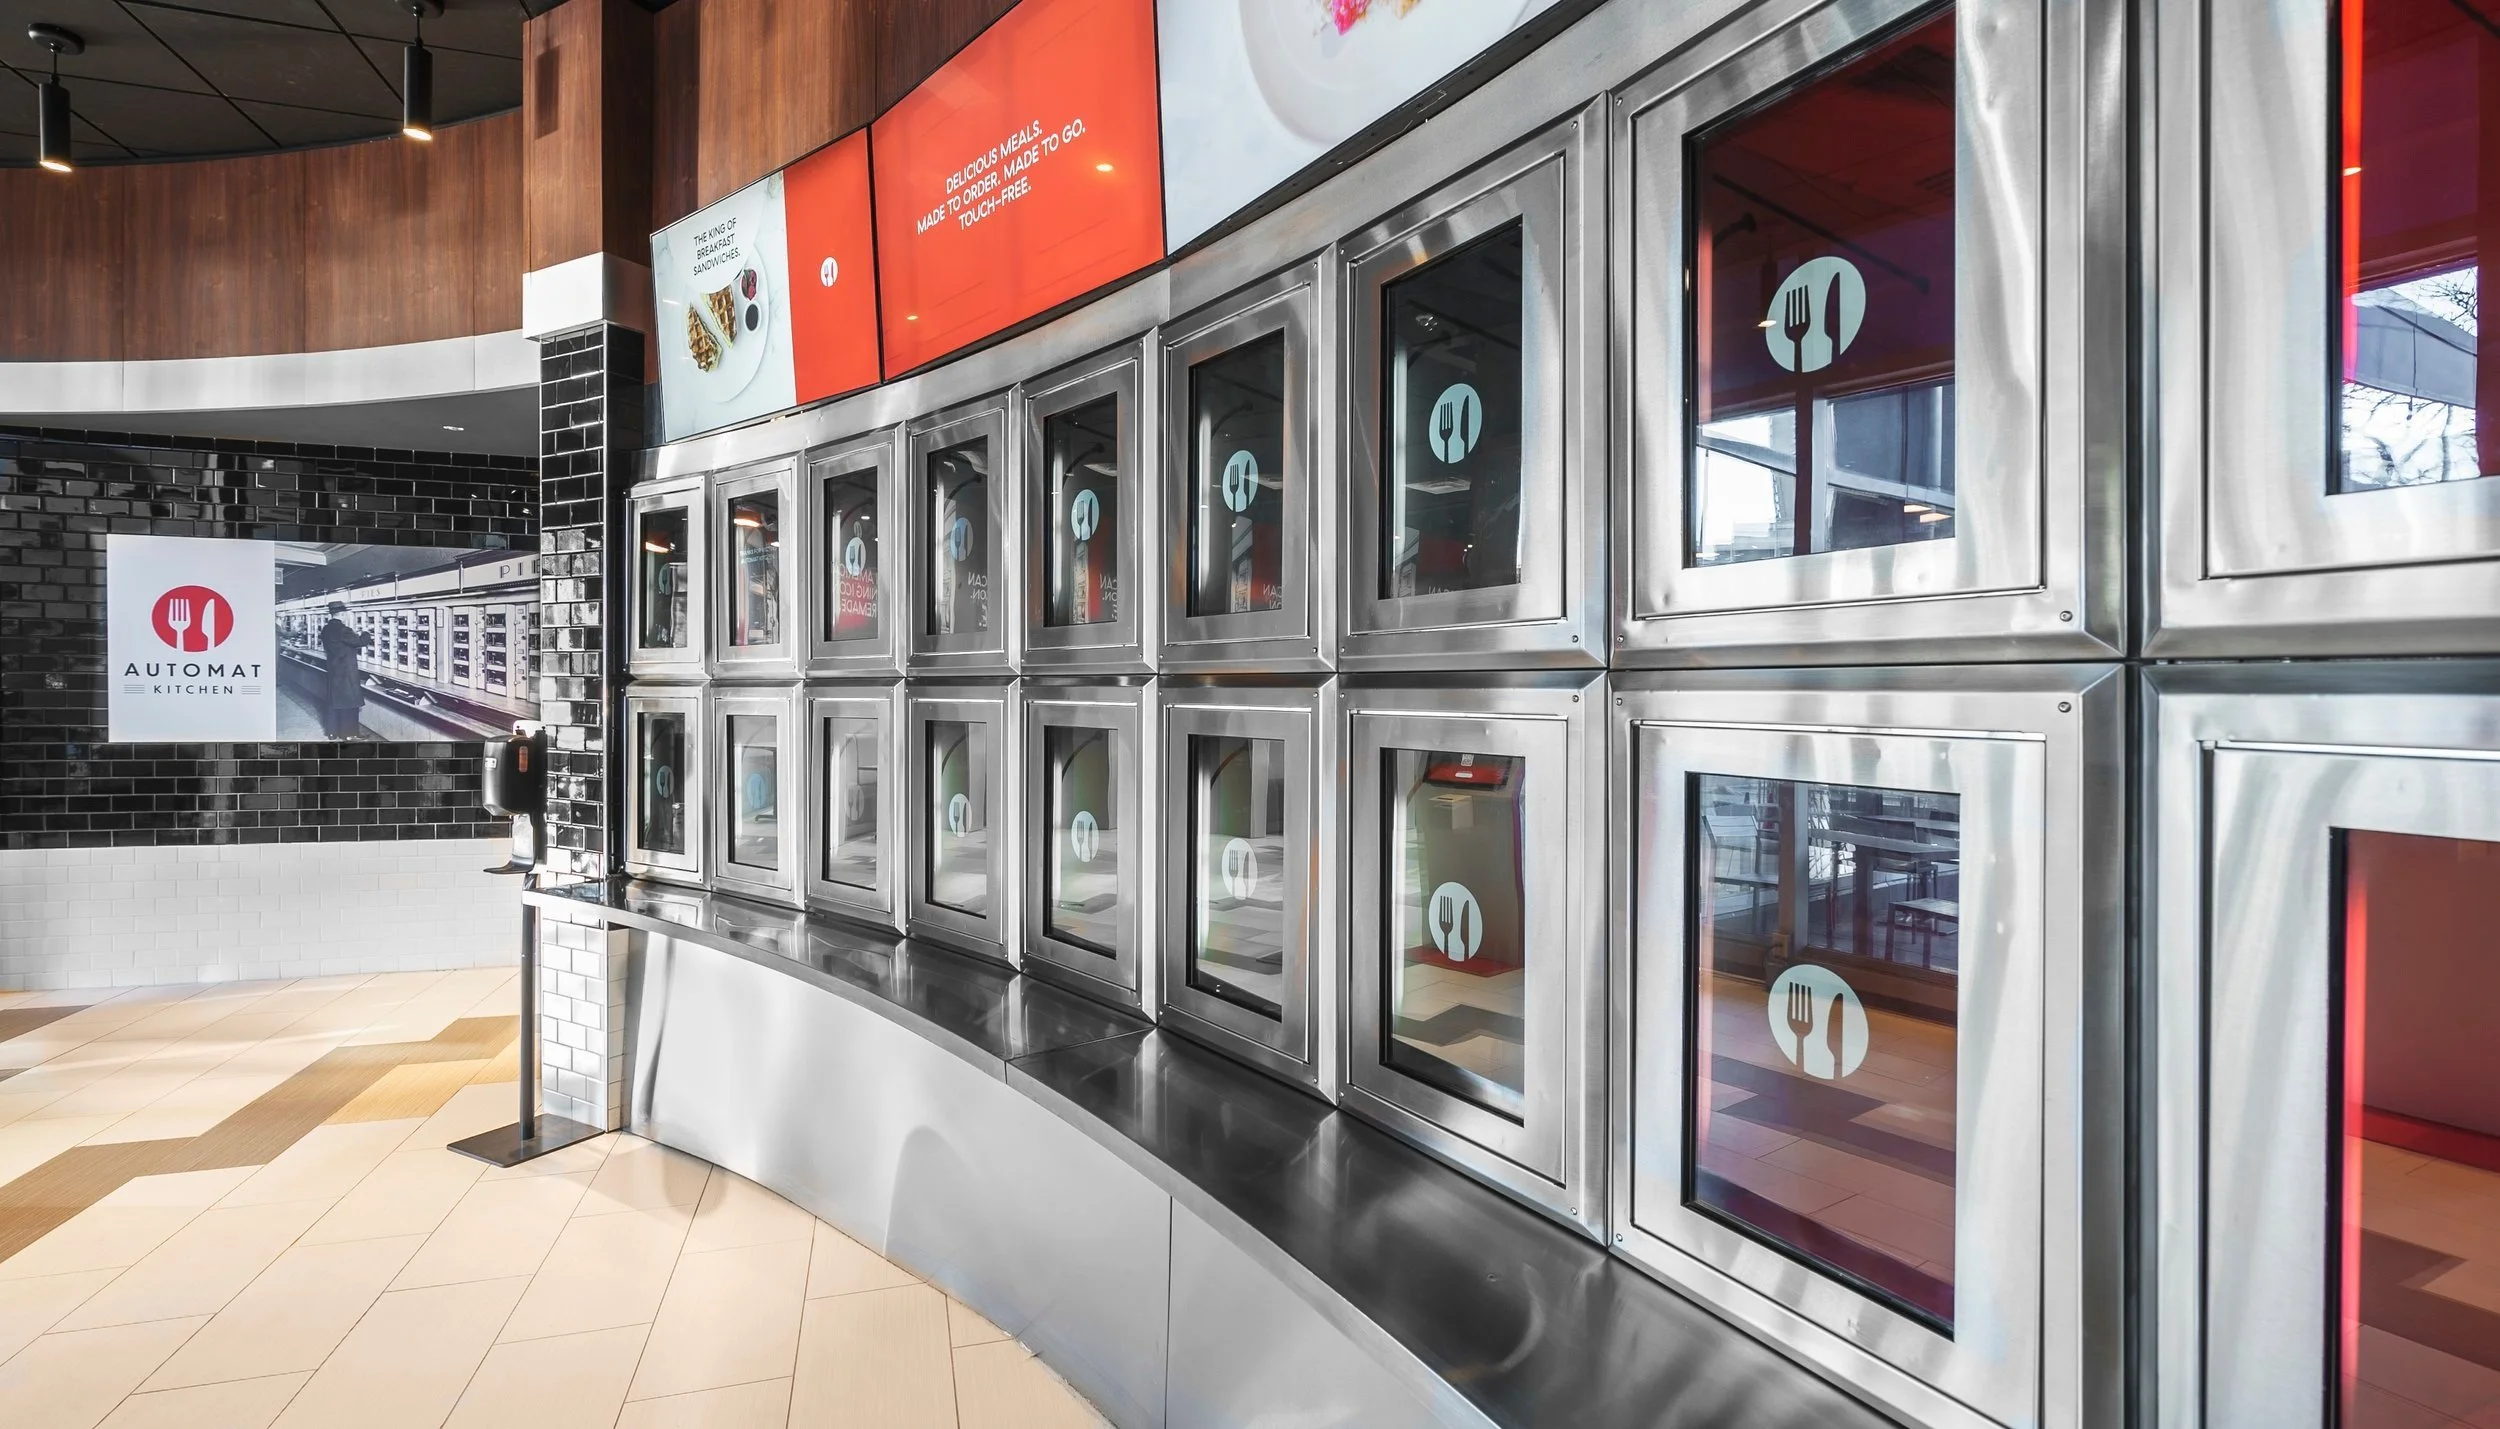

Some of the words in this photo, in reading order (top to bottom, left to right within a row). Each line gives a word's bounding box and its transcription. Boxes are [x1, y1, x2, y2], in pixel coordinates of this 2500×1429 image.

[946, 147, 998, 194] DELICIOUS
[1000, 119, 1043, 159] MEALS.
[917, 204, 946, 235] MADE
[947, 196, 961, 215] TO
[963, 171, 1001, 205] ORDER.
[1003, 145, 1040, 179] MADE
[1041, 133, 1059, 156] TO
[1062, 118, 1086, 143] GO.
[958, 175, 1032, 230] TOUCH-FREE.
[693, 232, 707, 246] THE
[708, 223, 726, 239] KING
[727, 217, 737, 230] OF
[696, 233, 735, 260] BREAKFAST
[693, 247, 741, 276] SANDWICHES.
[124, 663, 261, 678] AUTOMAT
[153, 685, 233, 695] KITCHEN
